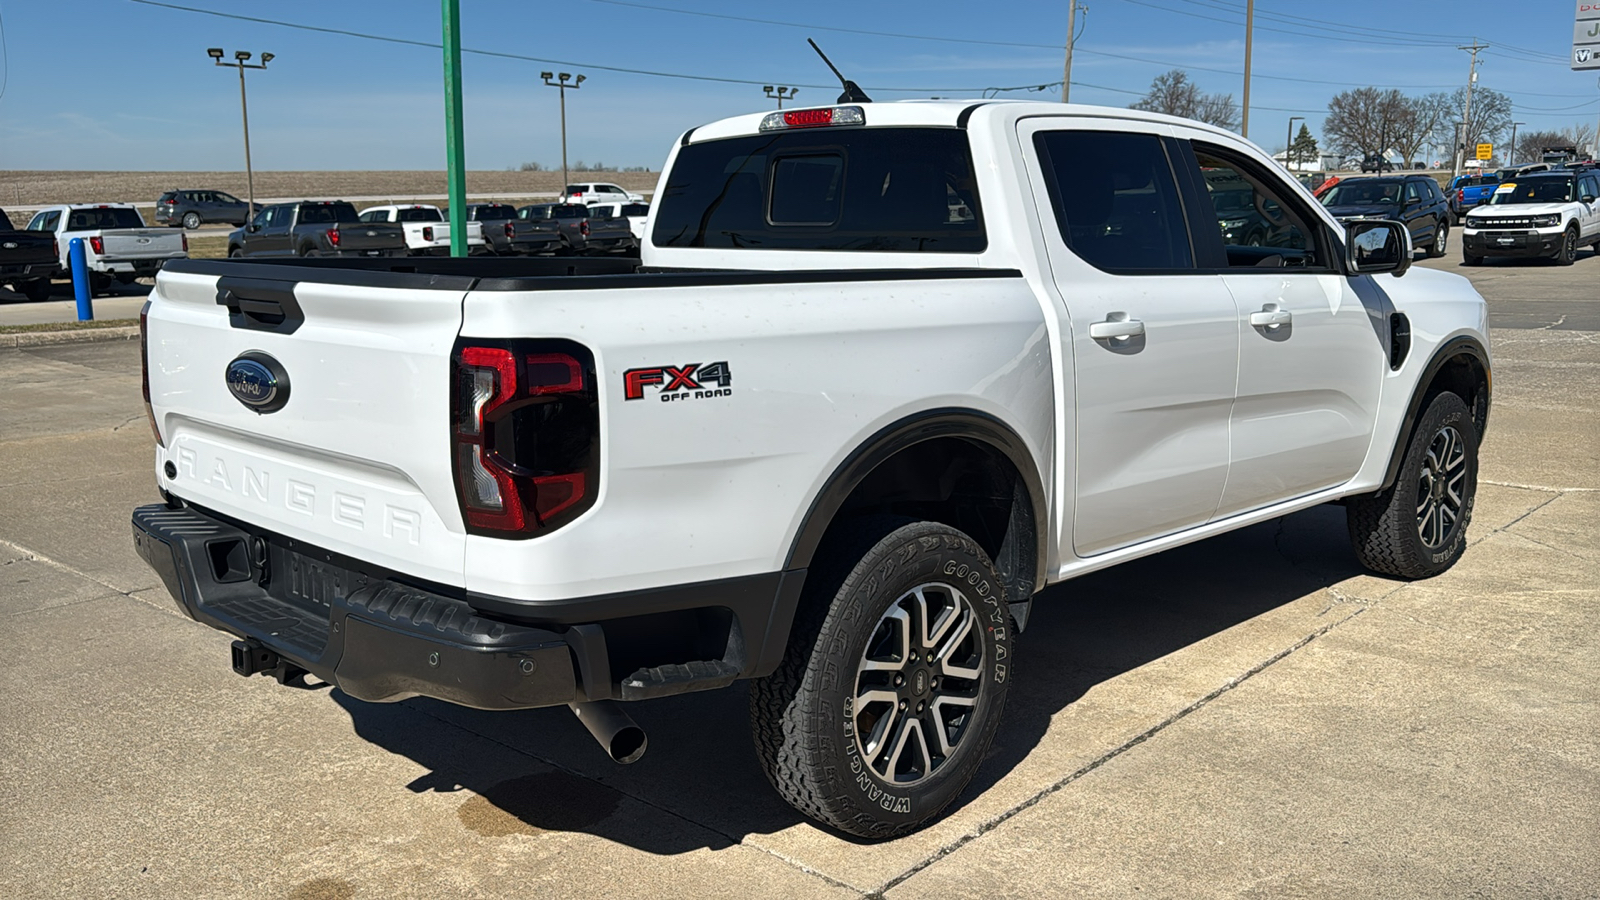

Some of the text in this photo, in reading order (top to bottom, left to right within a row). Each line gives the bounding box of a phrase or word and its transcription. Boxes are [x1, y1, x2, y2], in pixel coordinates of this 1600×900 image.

[1587, 22, 1600, 37] J
[234, 368, 262, 395] Ford
[623, 361, 732, 401] FX4
[660, 388, 732, 402] OFF ROAD
[176, 444, 422, 547] RANGER
[943, 559, 1007, 685] GOODYEAR
[843, 696, 911, 813] WRANGLER
